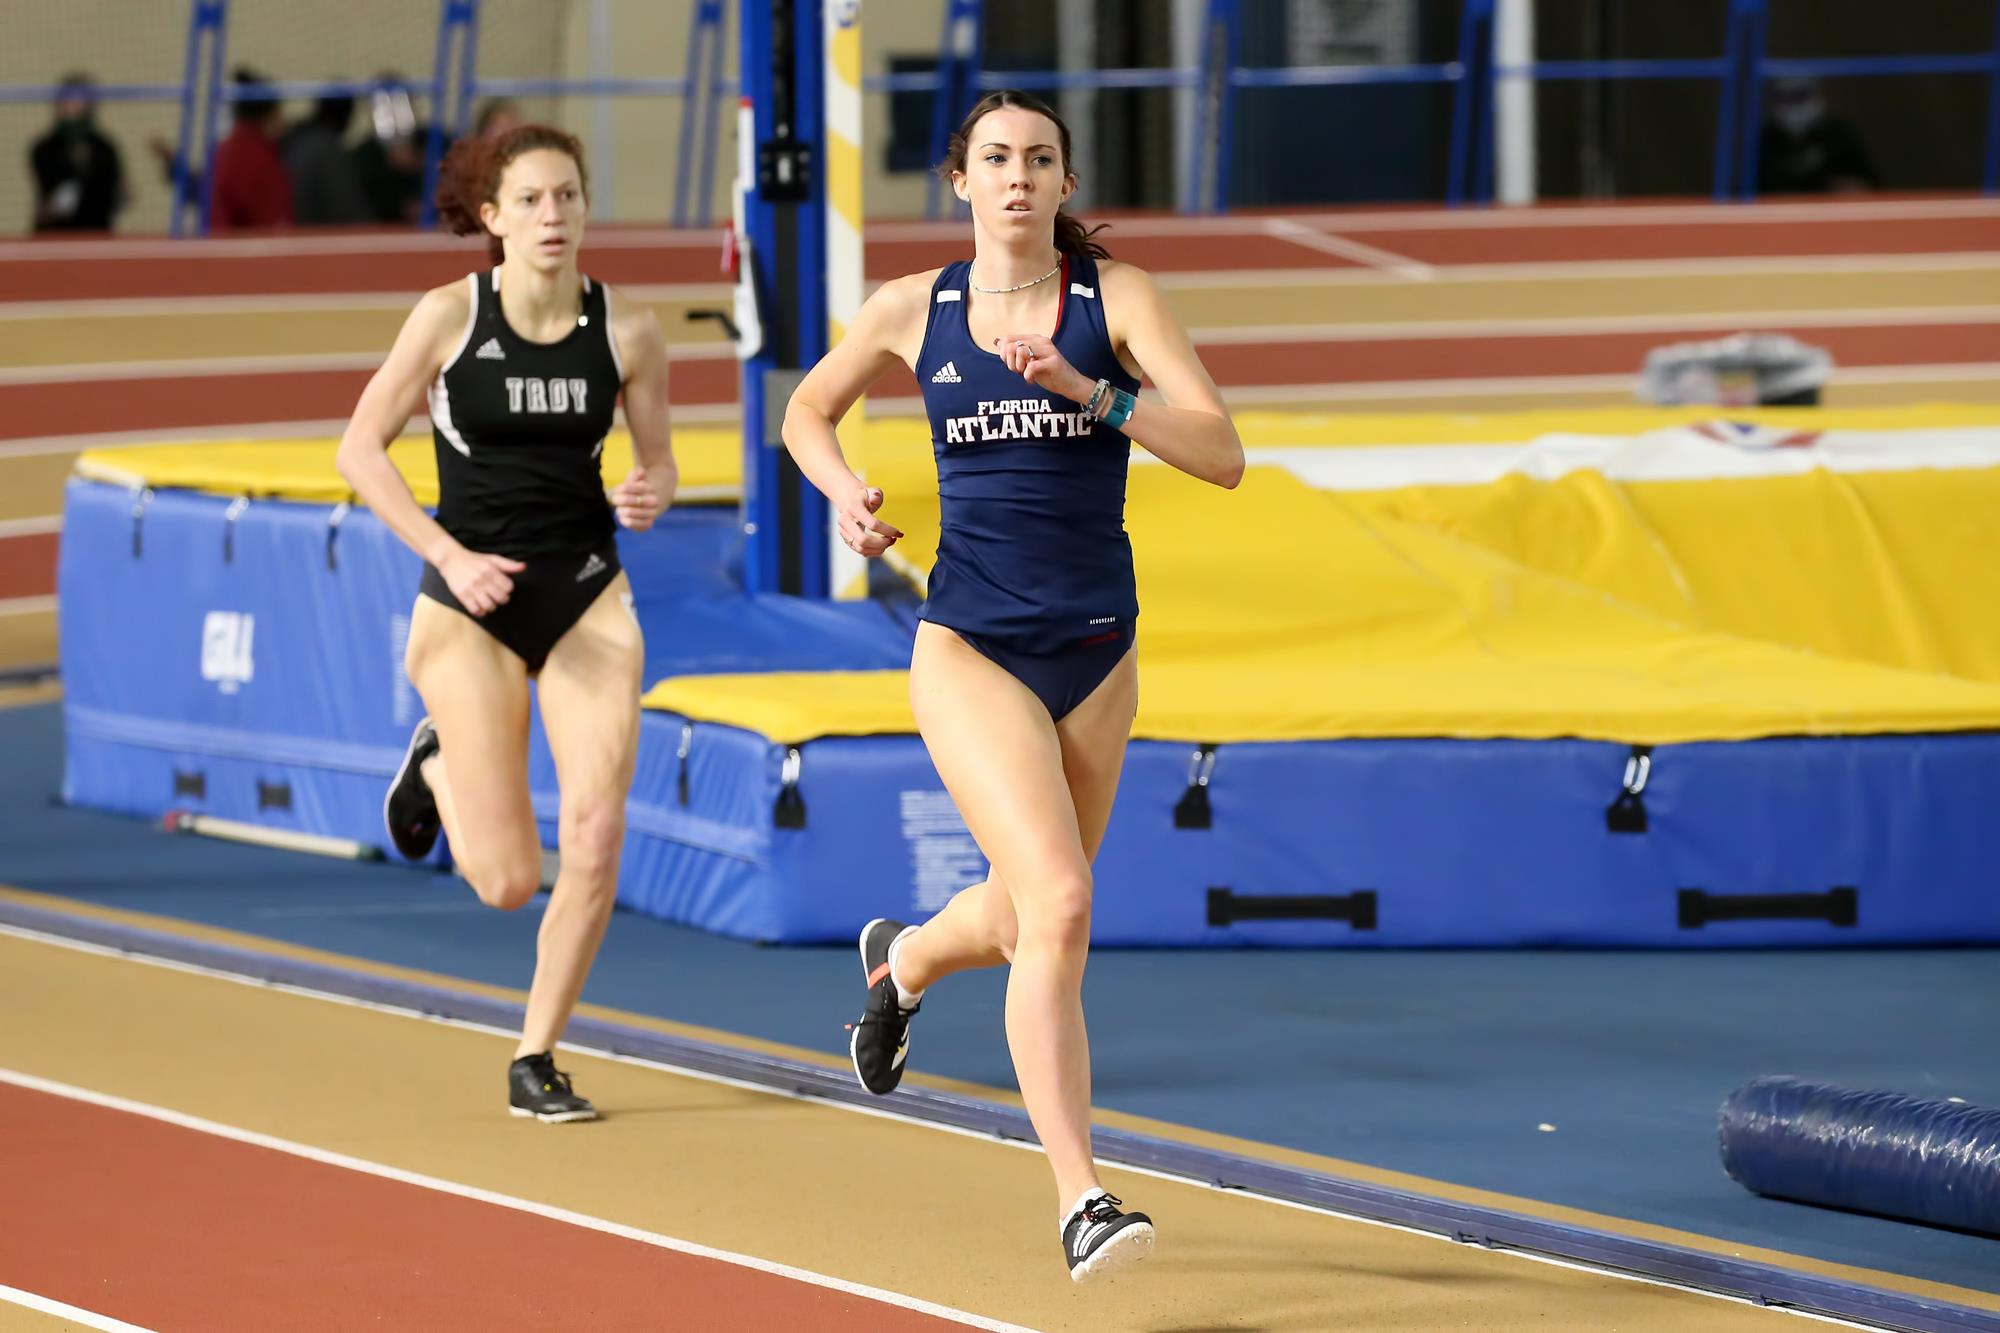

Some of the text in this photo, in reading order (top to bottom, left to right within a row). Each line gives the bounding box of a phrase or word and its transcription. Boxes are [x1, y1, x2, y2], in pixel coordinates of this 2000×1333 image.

[932, 375, 962, 383] adidas
[505, 377, 587, 414] TROY
[977, 399, 1052, 415] FLORIDA
[946, 412, 1092, 443] ATLANTIC
